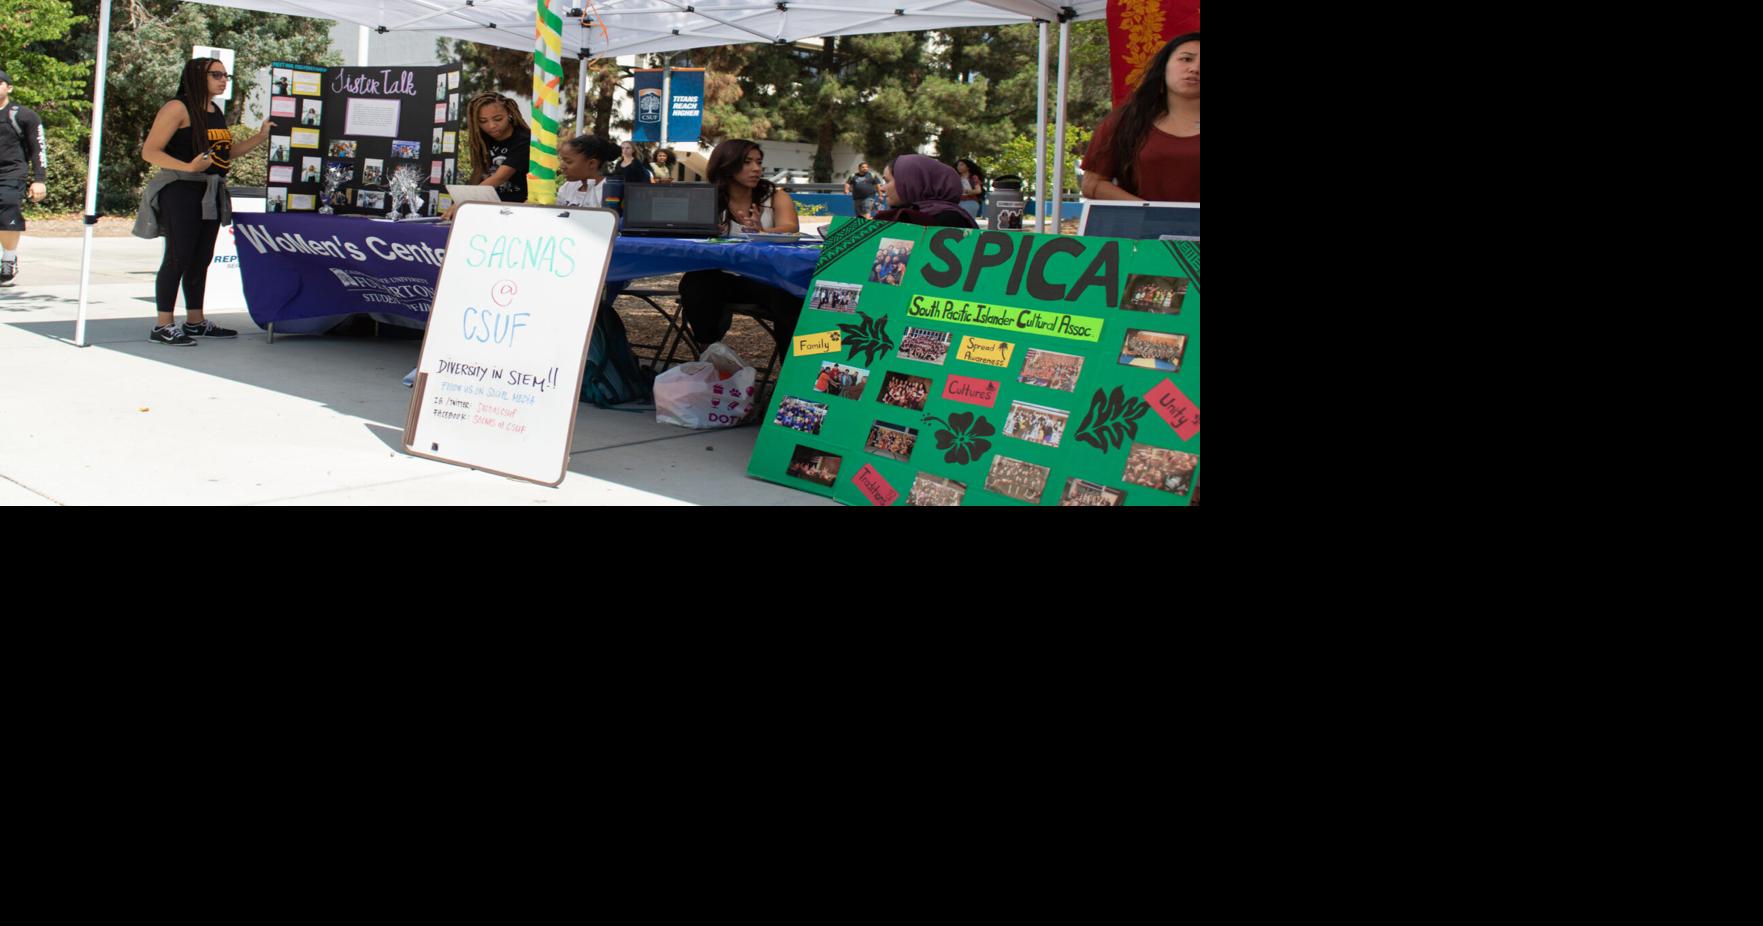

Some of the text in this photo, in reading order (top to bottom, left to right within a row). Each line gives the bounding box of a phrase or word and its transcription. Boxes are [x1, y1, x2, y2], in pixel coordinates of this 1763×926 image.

[379, 69, 417, 96] Talk
[214, 255, 239, 263] REP
[365, 235, 445, 267] Cente
[466, 234, 576, 277] SACNAS
[920, 228, 1119, 308] SPICA
[491, 279, 518, 307] @
[909, 295, 940, 317] South
[942, 300, 972, 323] Pacific
[972, 304, 1015, 326] Islander
[1016, 309, 1059, 332] Cultural
[463, 307, 531, 348] CSUF
[799, 338, 830, 353] Family
[966, 337, 996, 352] Spread
[437, 359, 489, 382] DIVERSITY
[491, 368, 504, 380] IN
[963, 351, 1005, 367] Awareness
[948, 380, 993, 400] Cultures
[1158, 392, 1189, 429] Unity
